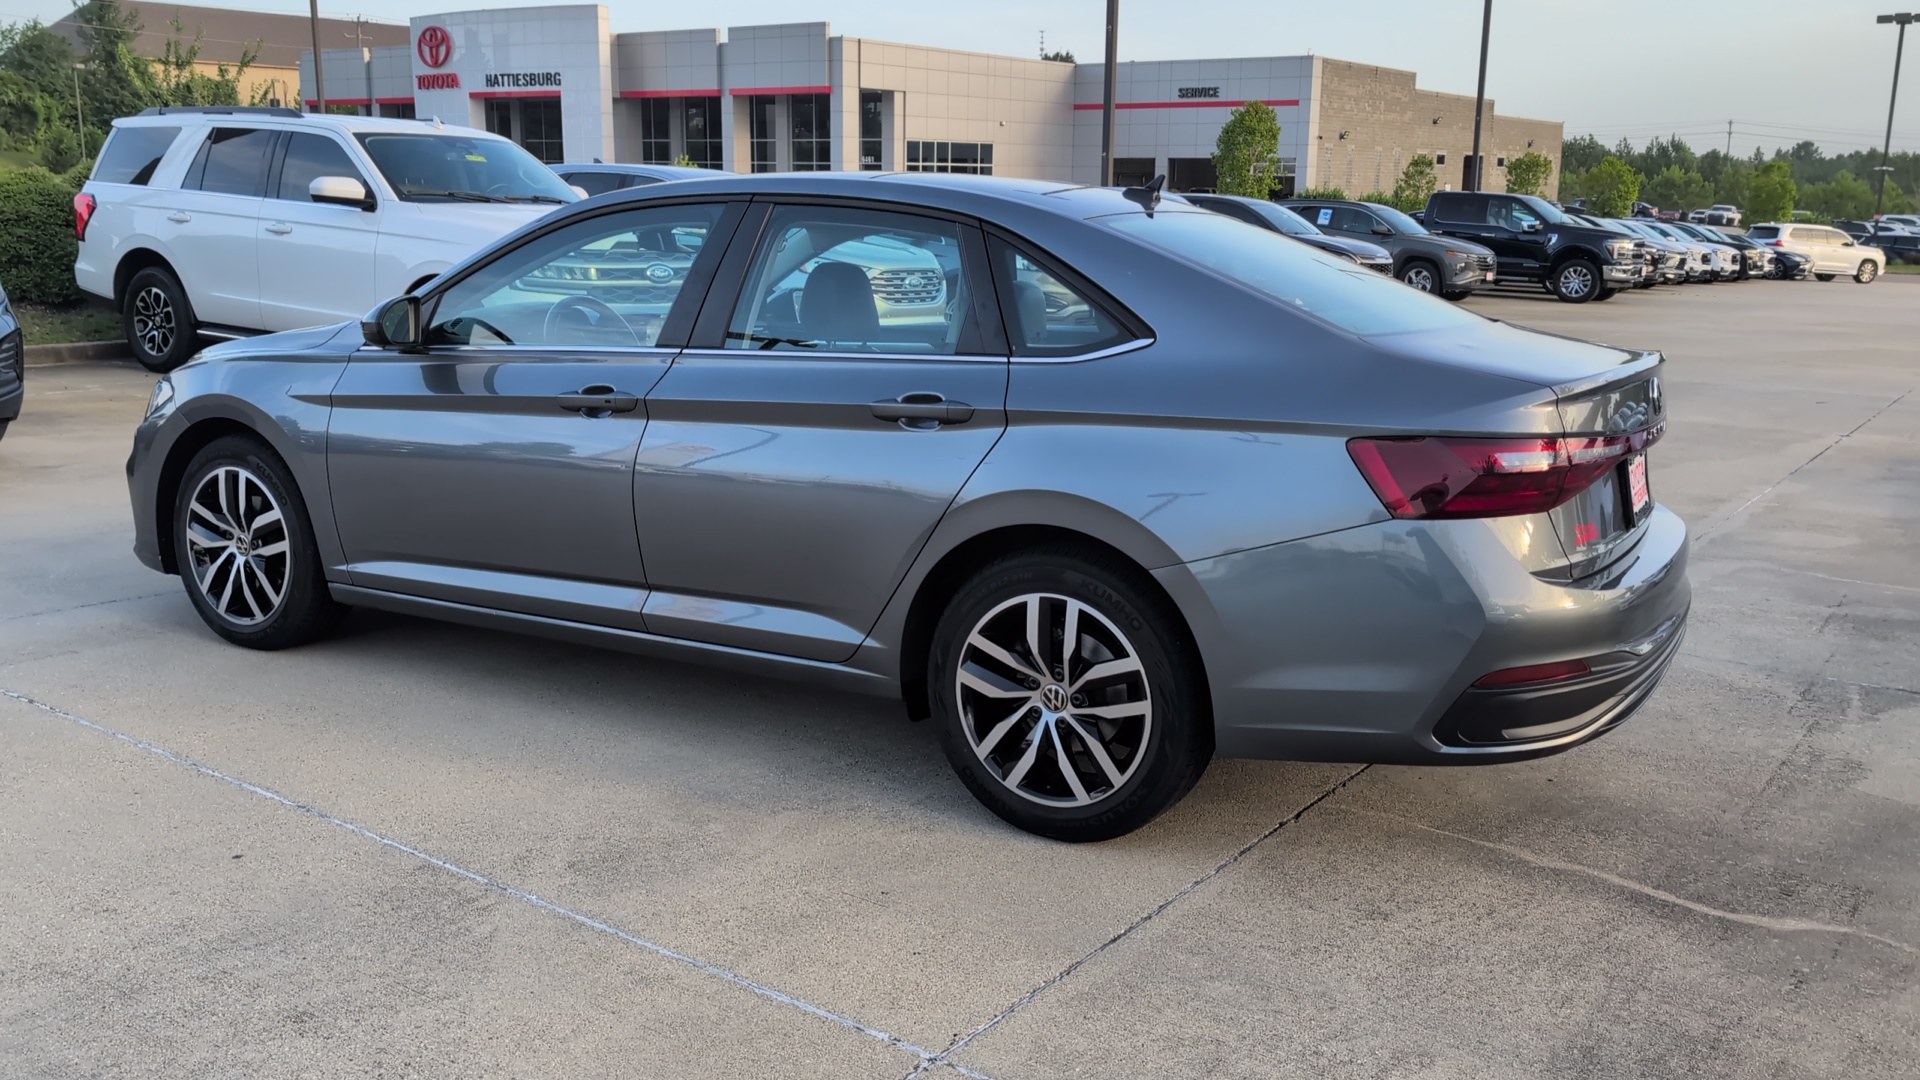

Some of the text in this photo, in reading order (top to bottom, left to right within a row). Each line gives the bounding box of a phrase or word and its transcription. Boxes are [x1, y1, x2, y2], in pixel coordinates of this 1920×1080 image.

[416, 73, 461, 90] TOYOTA
[485, 72, 562, 88] HATTIESBURG
[1178, 87, 1220, 99] SERVICE
[1080, 578, 1143, 632] KUMHO
